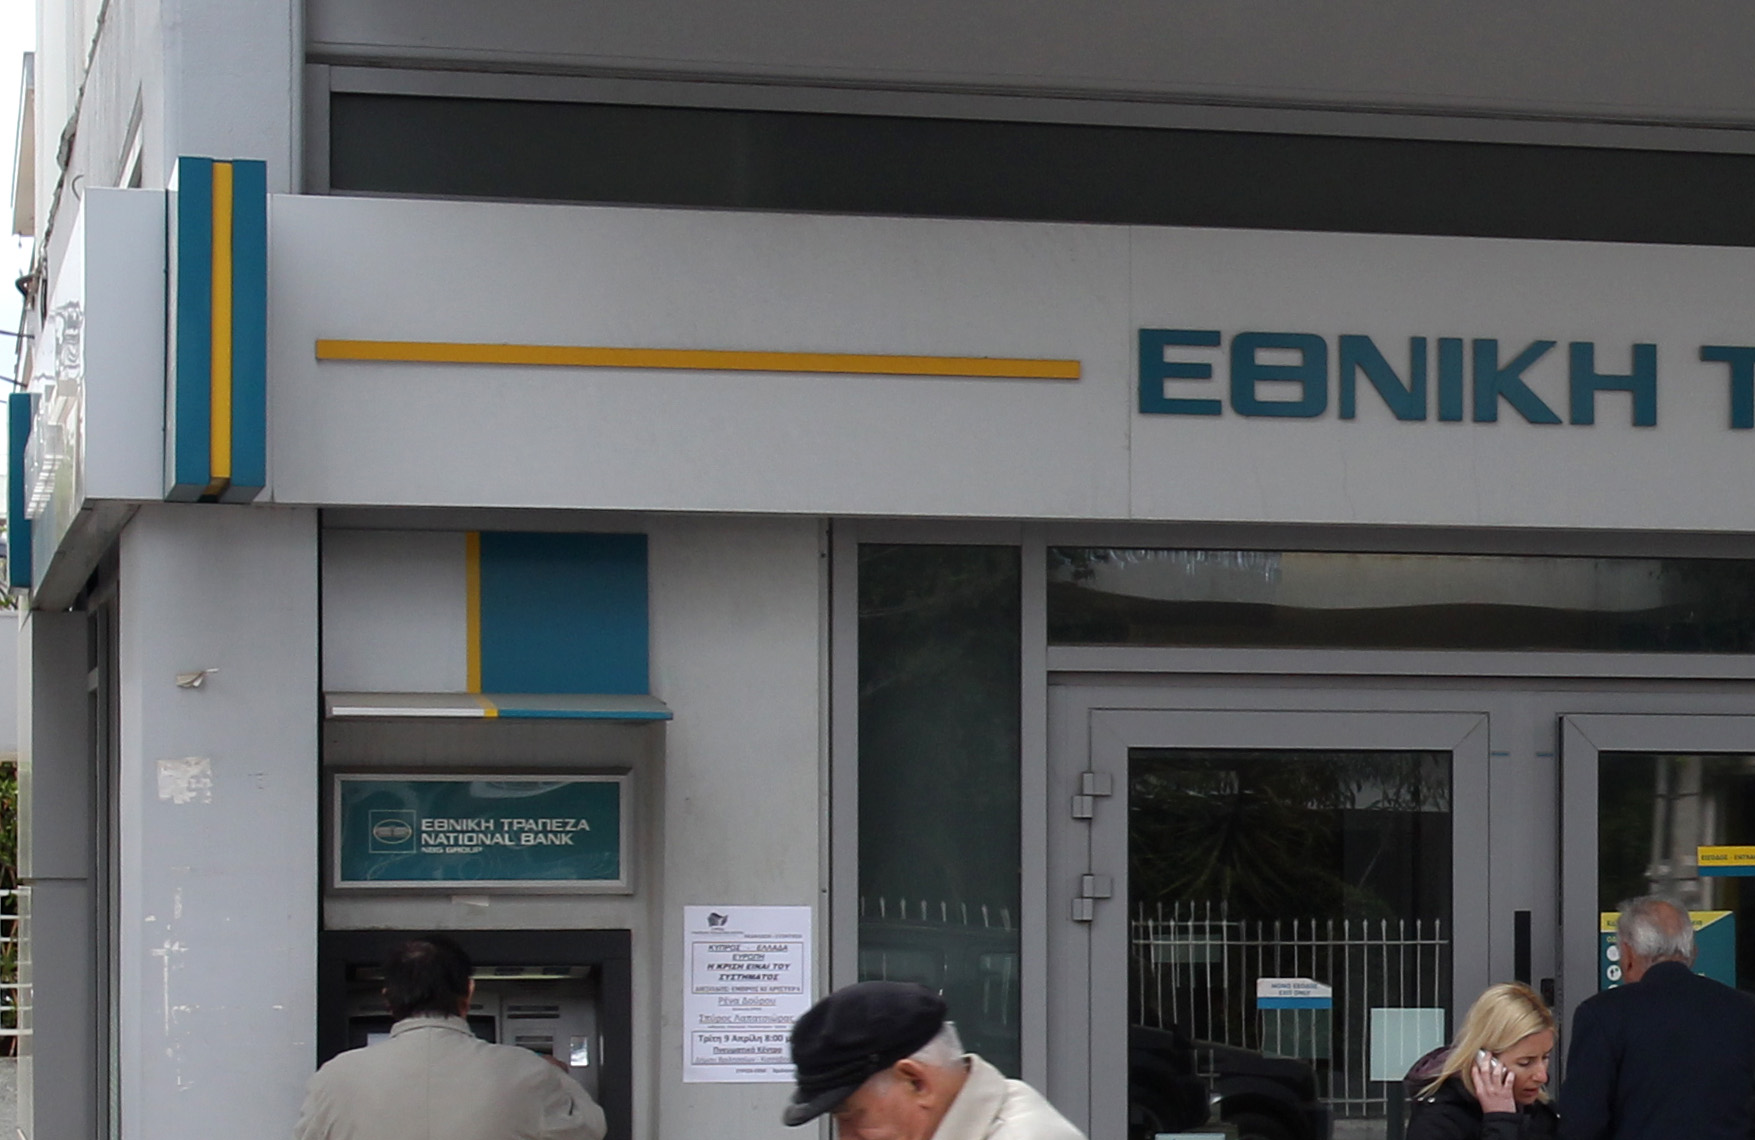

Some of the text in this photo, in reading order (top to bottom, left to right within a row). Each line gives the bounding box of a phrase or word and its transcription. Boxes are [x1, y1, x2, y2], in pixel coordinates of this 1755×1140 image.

[1138, 328, 1657, 428] ΕΘΝΙΚΗ
[420, 818, 591, 832] ΕΘΝΙΚΗ ΤΡΑΠΕΖΑ
[420, 832, 575, 846] NATIONAL BANK
[445, 846, 483, 854] GROUP
[764, 1034, 784, 1042] 8:00
